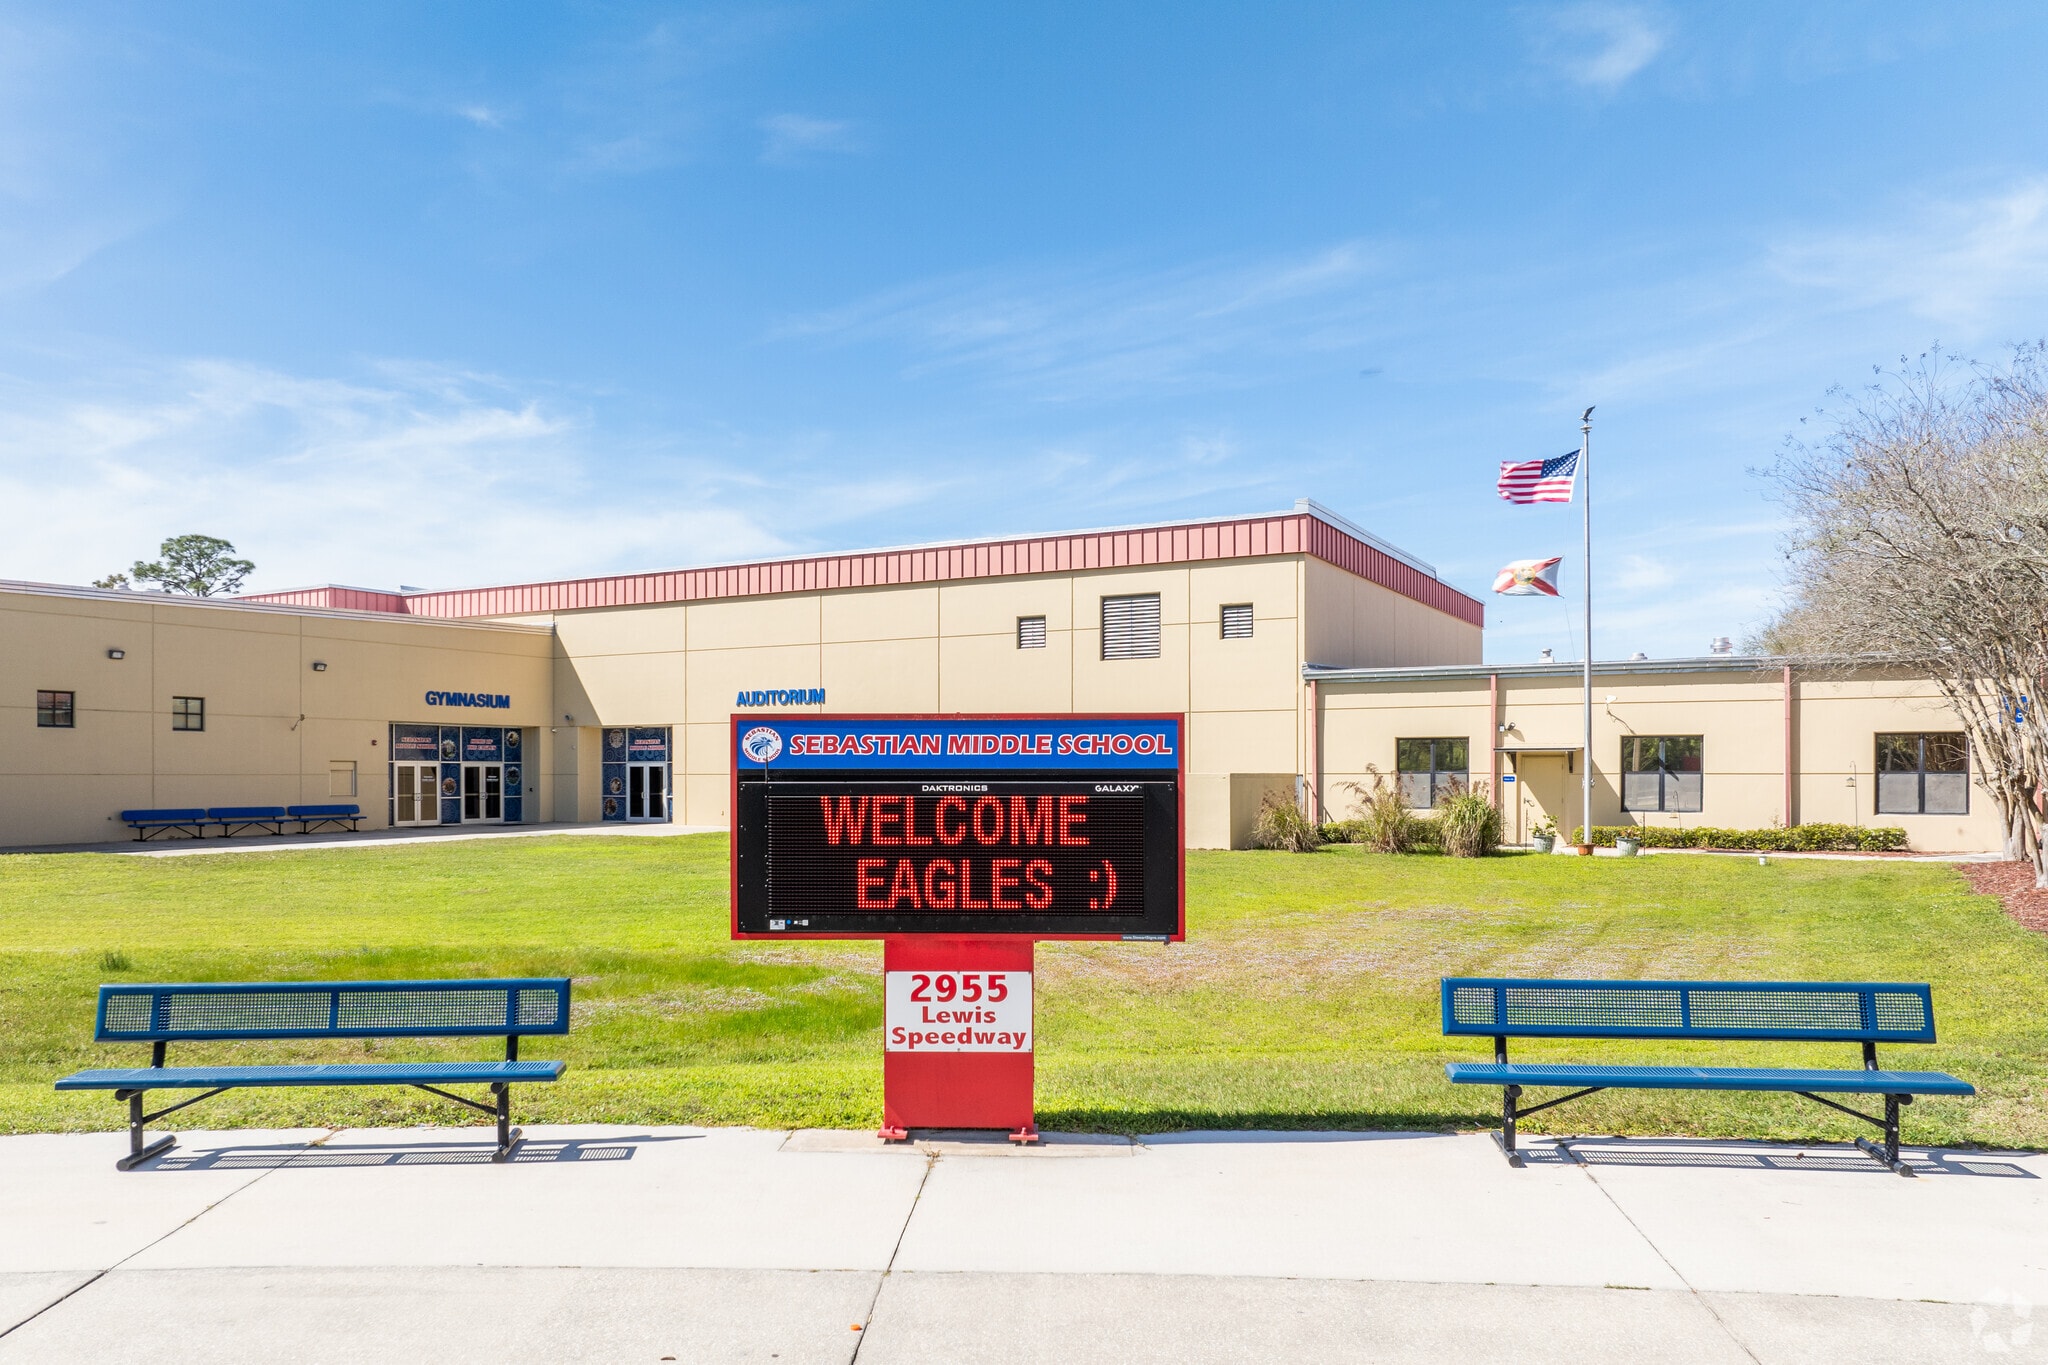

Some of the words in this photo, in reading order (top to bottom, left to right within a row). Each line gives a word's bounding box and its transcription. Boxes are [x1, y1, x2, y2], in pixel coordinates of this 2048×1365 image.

[425, 690, 510, 709] GYMNASIUM
[736, 688, 826, 707] AUDITORIUM
[745, 728, 780, 741] SEBASTIAN
[790, 734, 942, 755] SEBASTIAN
[947, 734, 1053, 755] MIDDLE
[1057, 734, 1173, 755] SCHOOL
[744, 747, 761, 762] MIDDLE
[921, 784, 989, 792] DAKTRONICS
[820, 796, 1090, 845] WELCOME
[857, 858, 1053, 910] EAGLES
[910, 974, 1008, 1003] 2955
[922, 1006, 997, 1024] Lewis
[892, 1026, 1027, 1050] Speedway
